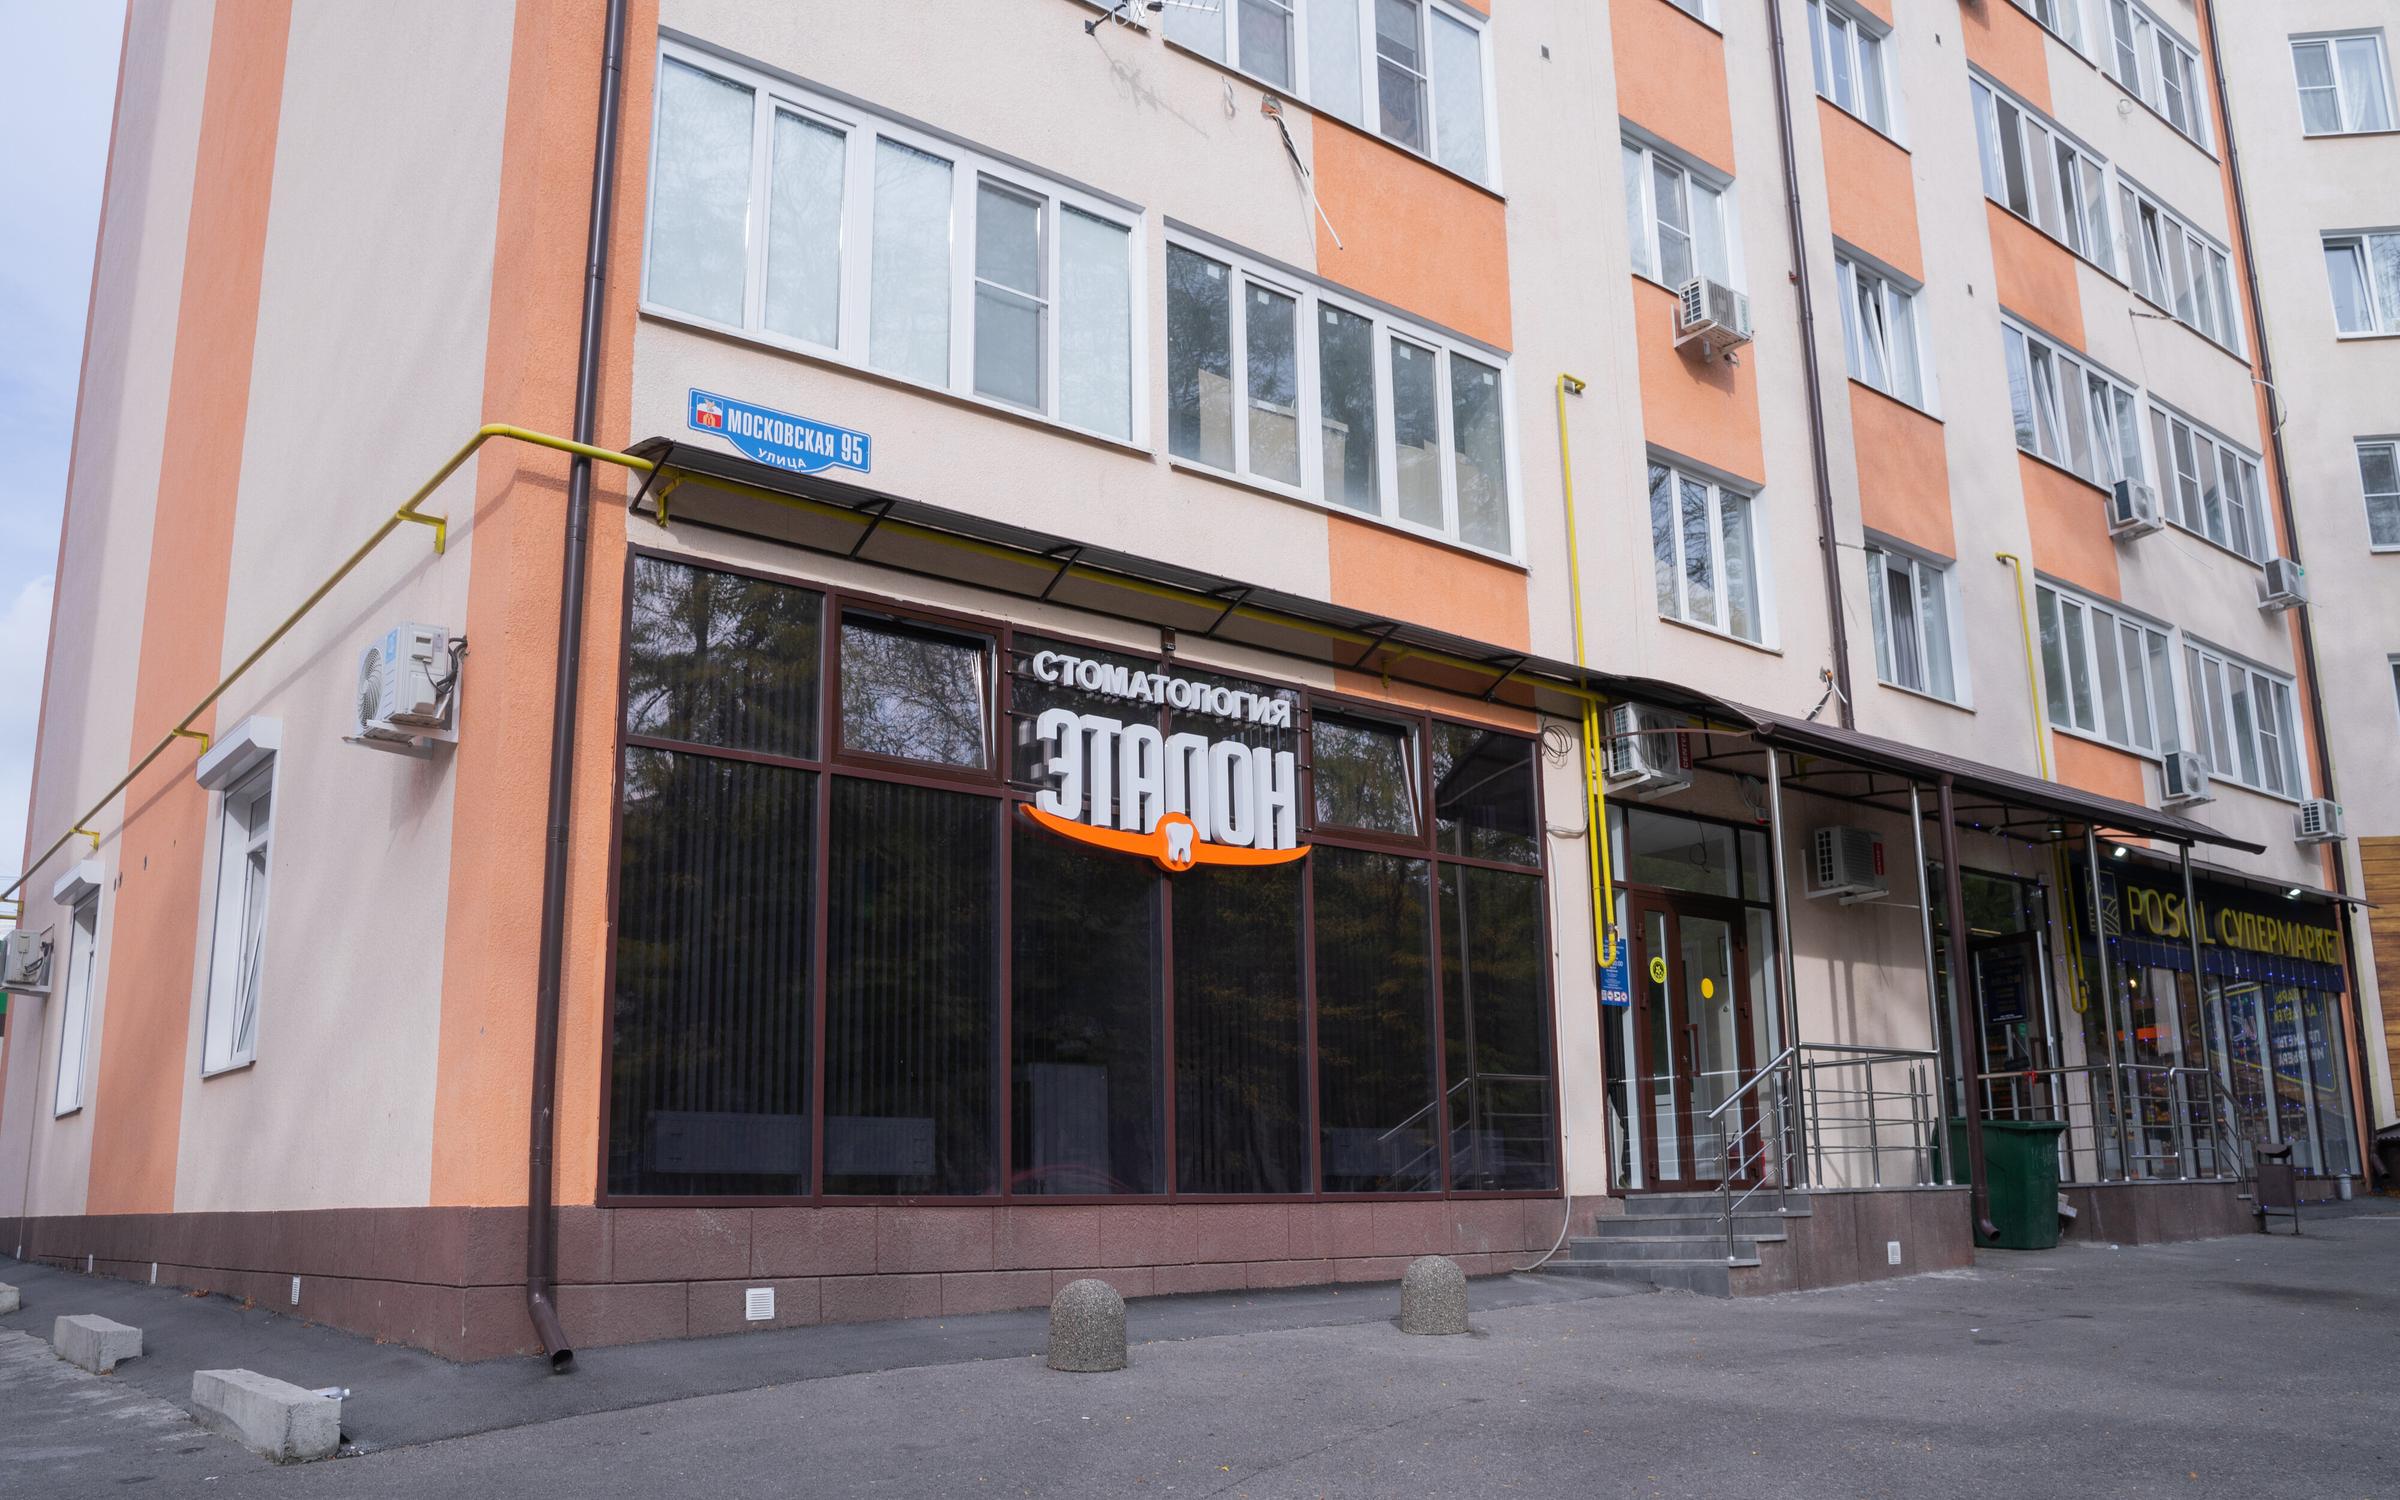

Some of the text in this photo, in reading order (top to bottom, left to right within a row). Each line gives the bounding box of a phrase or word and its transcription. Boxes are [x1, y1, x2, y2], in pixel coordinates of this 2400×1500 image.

[727, 408, 863, 465] МОСКОВСКАЯ 95
[758, 448, 806, 469] УЛИЦА
[1033, 650, 1290, 728] СТОМАТОЛОГИЯ
[1036, 708, 1296, 850] ЭТАЛОН
[2219, 907, 2341, 965] СУПЕРМАРКЕТ
